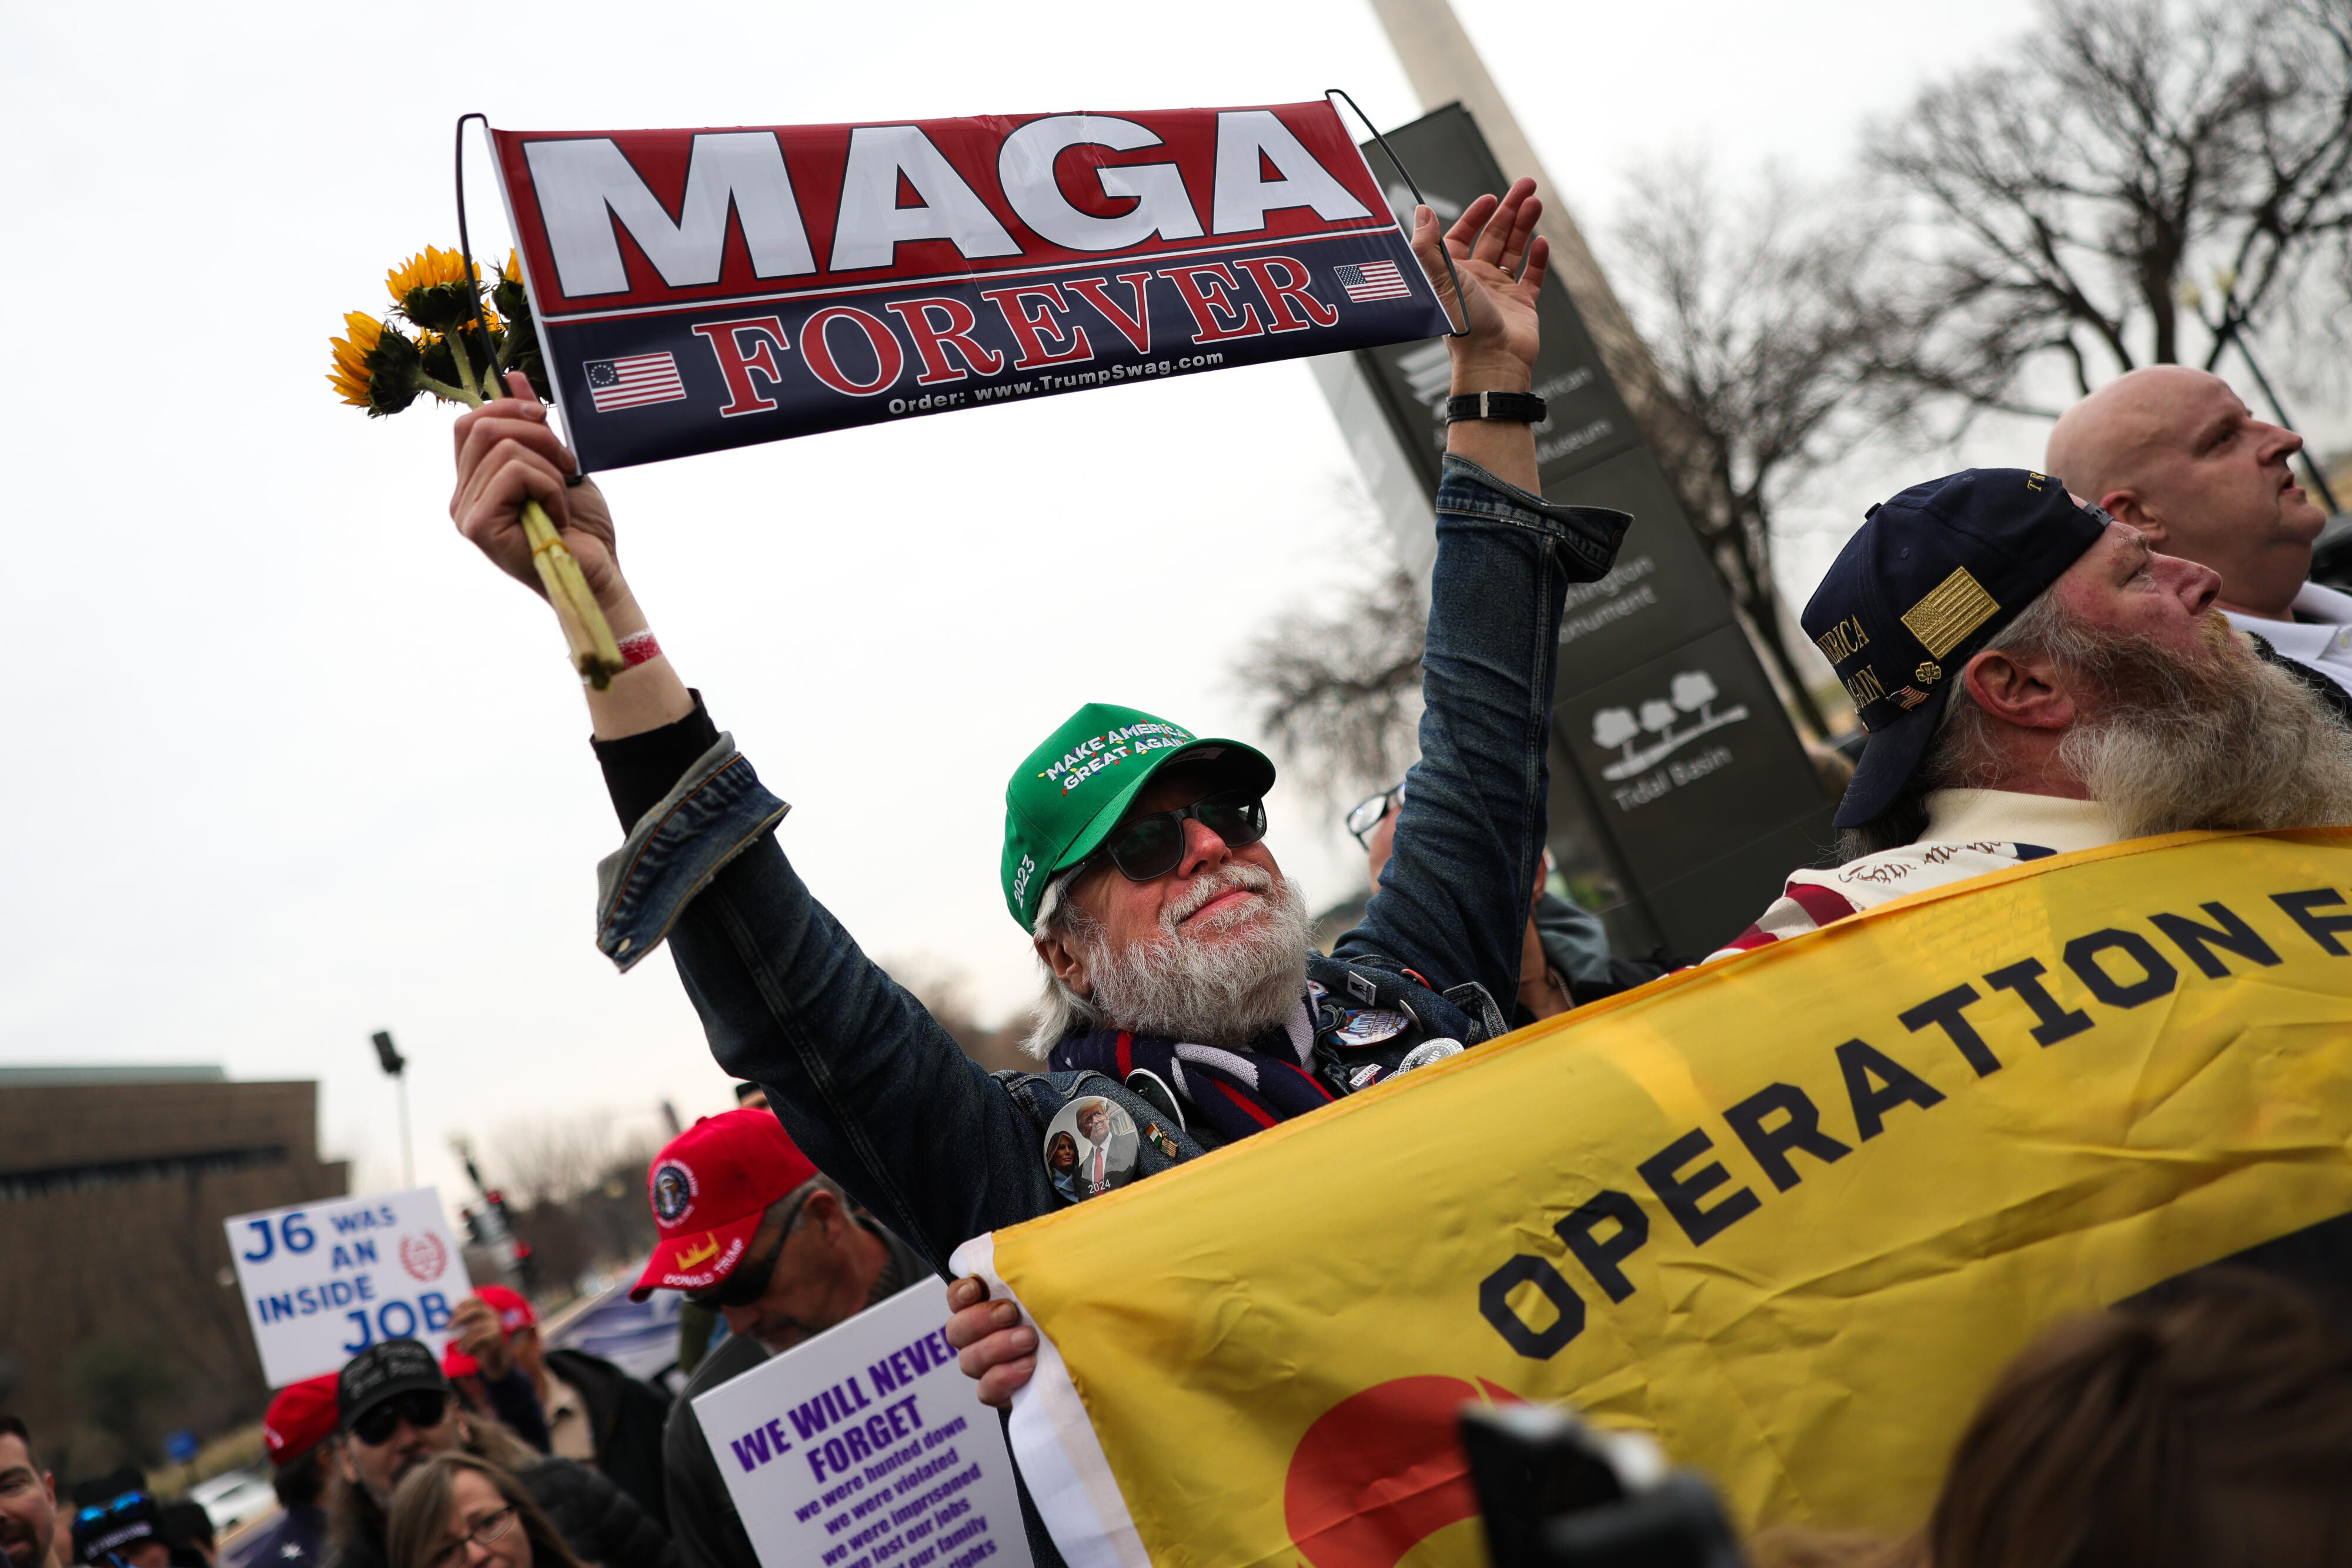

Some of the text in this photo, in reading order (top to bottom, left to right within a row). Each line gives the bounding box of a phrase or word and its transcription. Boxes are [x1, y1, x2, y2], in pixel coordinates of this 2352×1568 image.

[523, 110, 1374, 299] MAGA
[692, 256, 1339, 418] FOREVER
[888, 352, 1224, 414] Order: www.TrumpSwag.com
[1559, 583, 1659, 644] onument
[1847, 664, 1887, 709] GAIN
[1046, 723, 1191, 781] MAKE AMERICA
[1064, 745, 1129, 790] GREAT
[1610, 745, 1735, 813] Tidal Basin
[1014, 854, 1035, 909] 2023
[1353, 1072, 1368, 1085] EARLY
[1366, 1065, 1379, 1074] VOTE
[1479, 887, 2352, 1360] OPERATION F
[1088, 1179, 1111, 1194] 2024
[244, 1206, 397, 1263] J6 WAS
[332, 1239, 378, 1271] AN
[662, 1236, 745, 1287] DONALD TRUMP
[258, 1275, 376, 1325] INSIDE
[343, 1292, 452, 1356] JOB
[730, 1417, 793, 1474] WE
[786, 1376, 872, 1442] WILL
[805, 1393, 924, 1485] FORGET
[794, 1416, 968, 1523] we were hunted down
[824, 1446, 960, 1535] we were violated
[822, 1462, 983, 1567] we were imprisoned
[871, 1534, 907, 1564] lost
[906, 1519, 934, 1544] our
[934, 1498, 972, 1530] jobs
[908, 1515, 988, 1568] our family
[948, 1539, 998, 1568] rights
